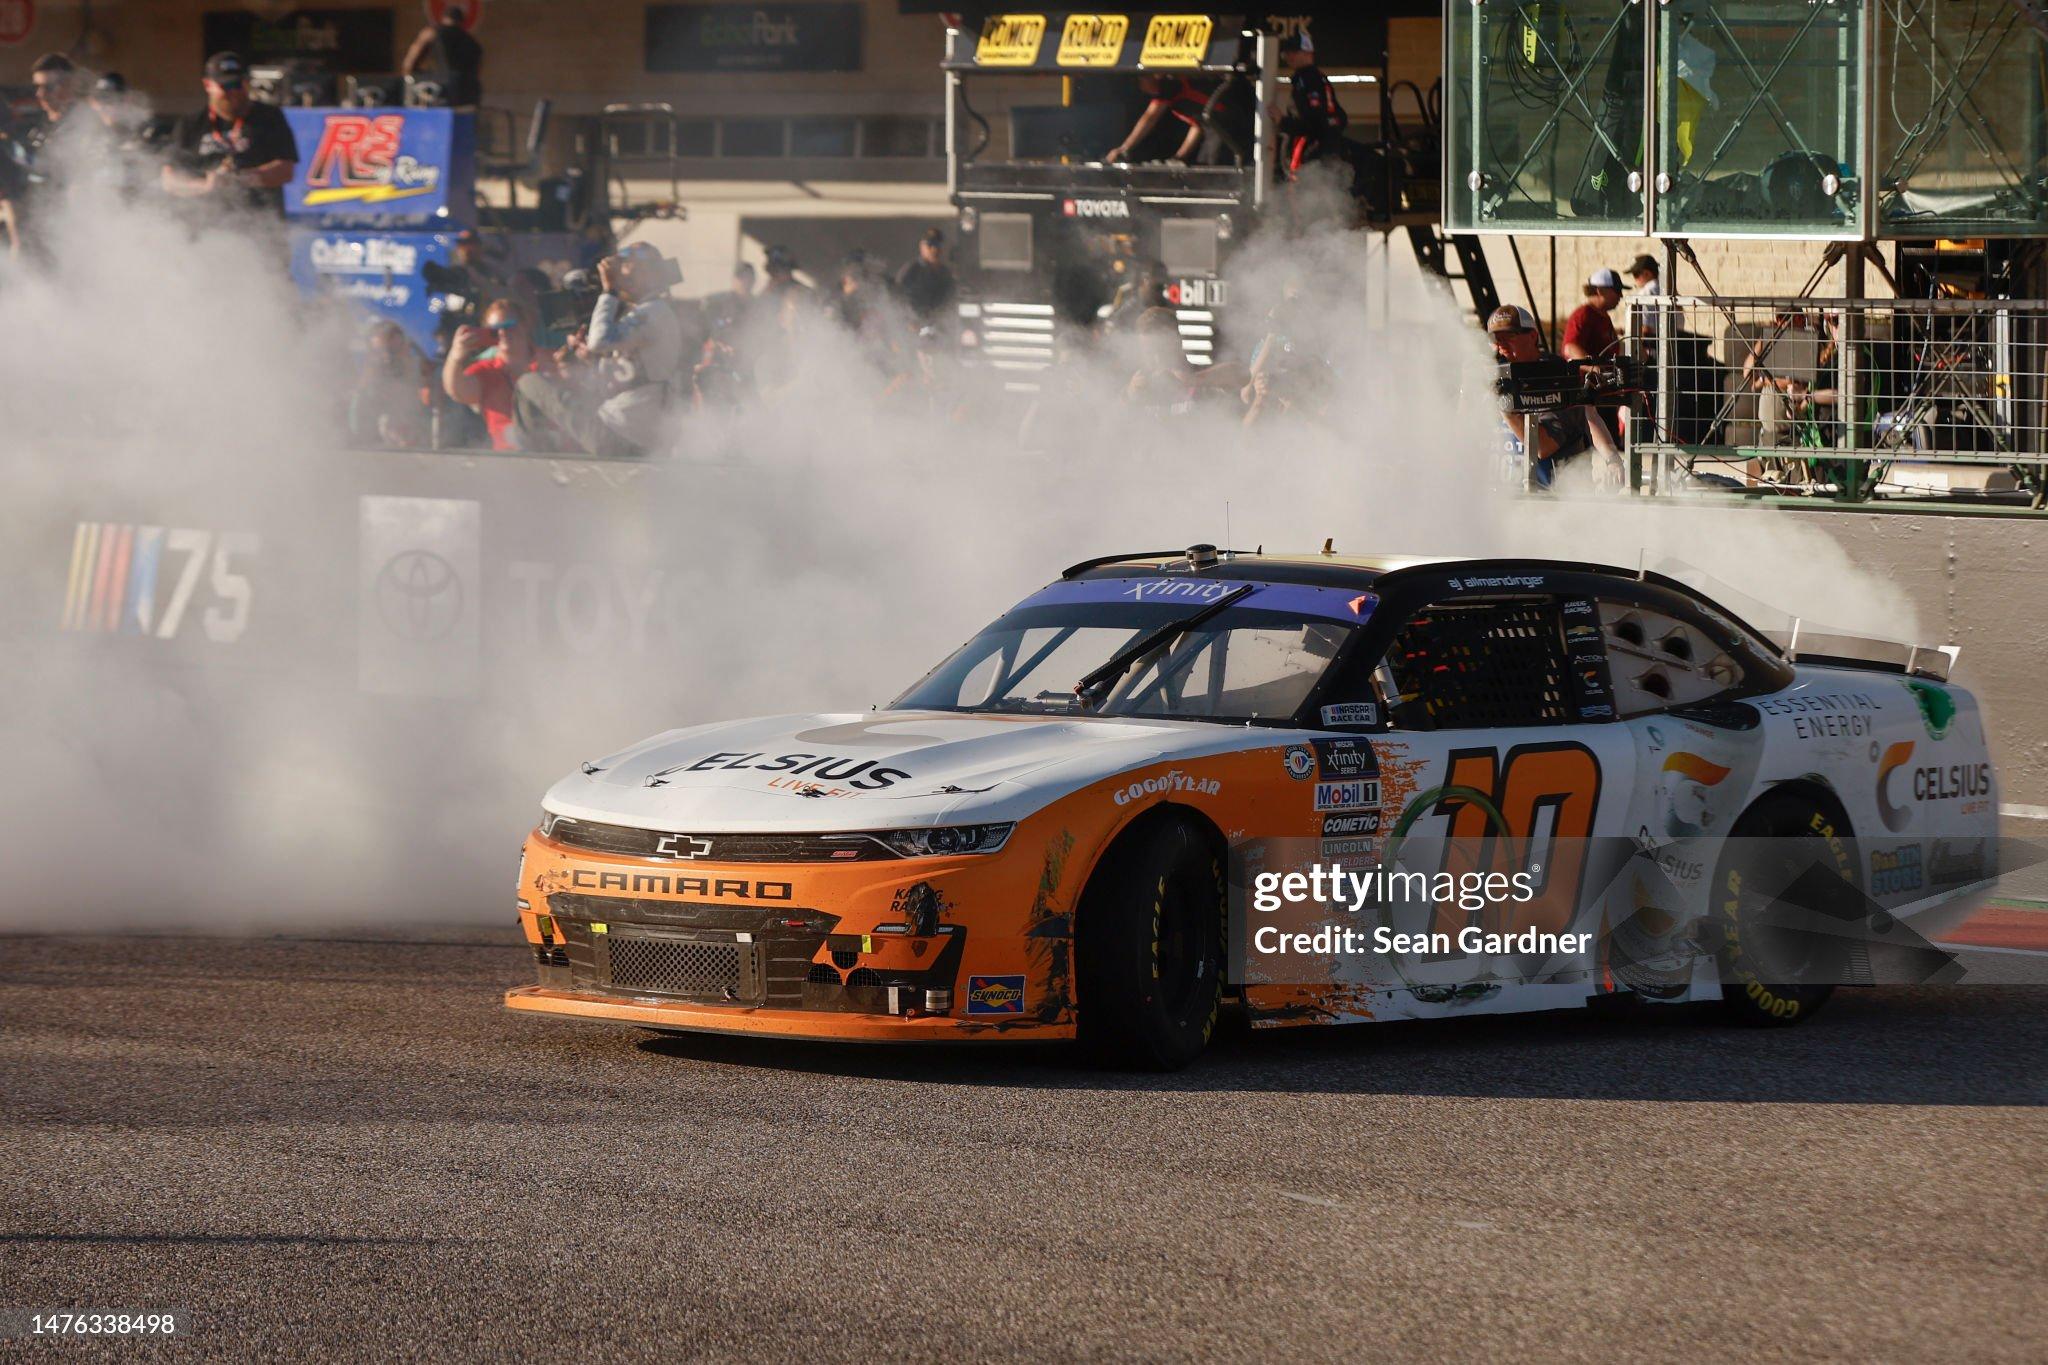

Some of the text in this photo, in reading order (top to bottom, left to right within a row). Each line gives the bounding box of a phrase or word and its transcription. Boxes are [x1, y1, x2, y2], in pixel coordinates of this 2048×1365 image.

[1068, 21, 1122, 47] ROMCO
[1151, 21, 1206, 47] ROMCO
[1074, 199, 1130, 218] TOYOTA
[1163, 279, 1206, 306] obil
[1520, 392, 1562, 405] WHELEN
[156, 528, 261, 643] 75
[1123, 578, 1243, 603] xfinity
[1464, 576, 1544, 588] allmendinger
[1339, 705, 1370, 714] NASCAR
[1758, 694, 1883, 716] ESSENTIAL
[1331, 714, 1370, 723] RACE CAR
[1793, 715, 1872, 739] ENERGY
[1327, 749, 1366, 771] xfinity
[1341, 766, 1358, 775] SERIES
[1113, 773, 1222, 806] GOODYEAR
[1913, 763, 1990, 801] CELSIUS
[1318, 783, 1360, 805] Mobil
[1324, 815, 1379, 832] COMETIC
[1324, 840, 1372, 855] LINCOLN
[1421, 741, 1603, 964] 10
[572, 869, 793, 901] CAMARO
[971, 989, 1021, 1001] SUNOCO
